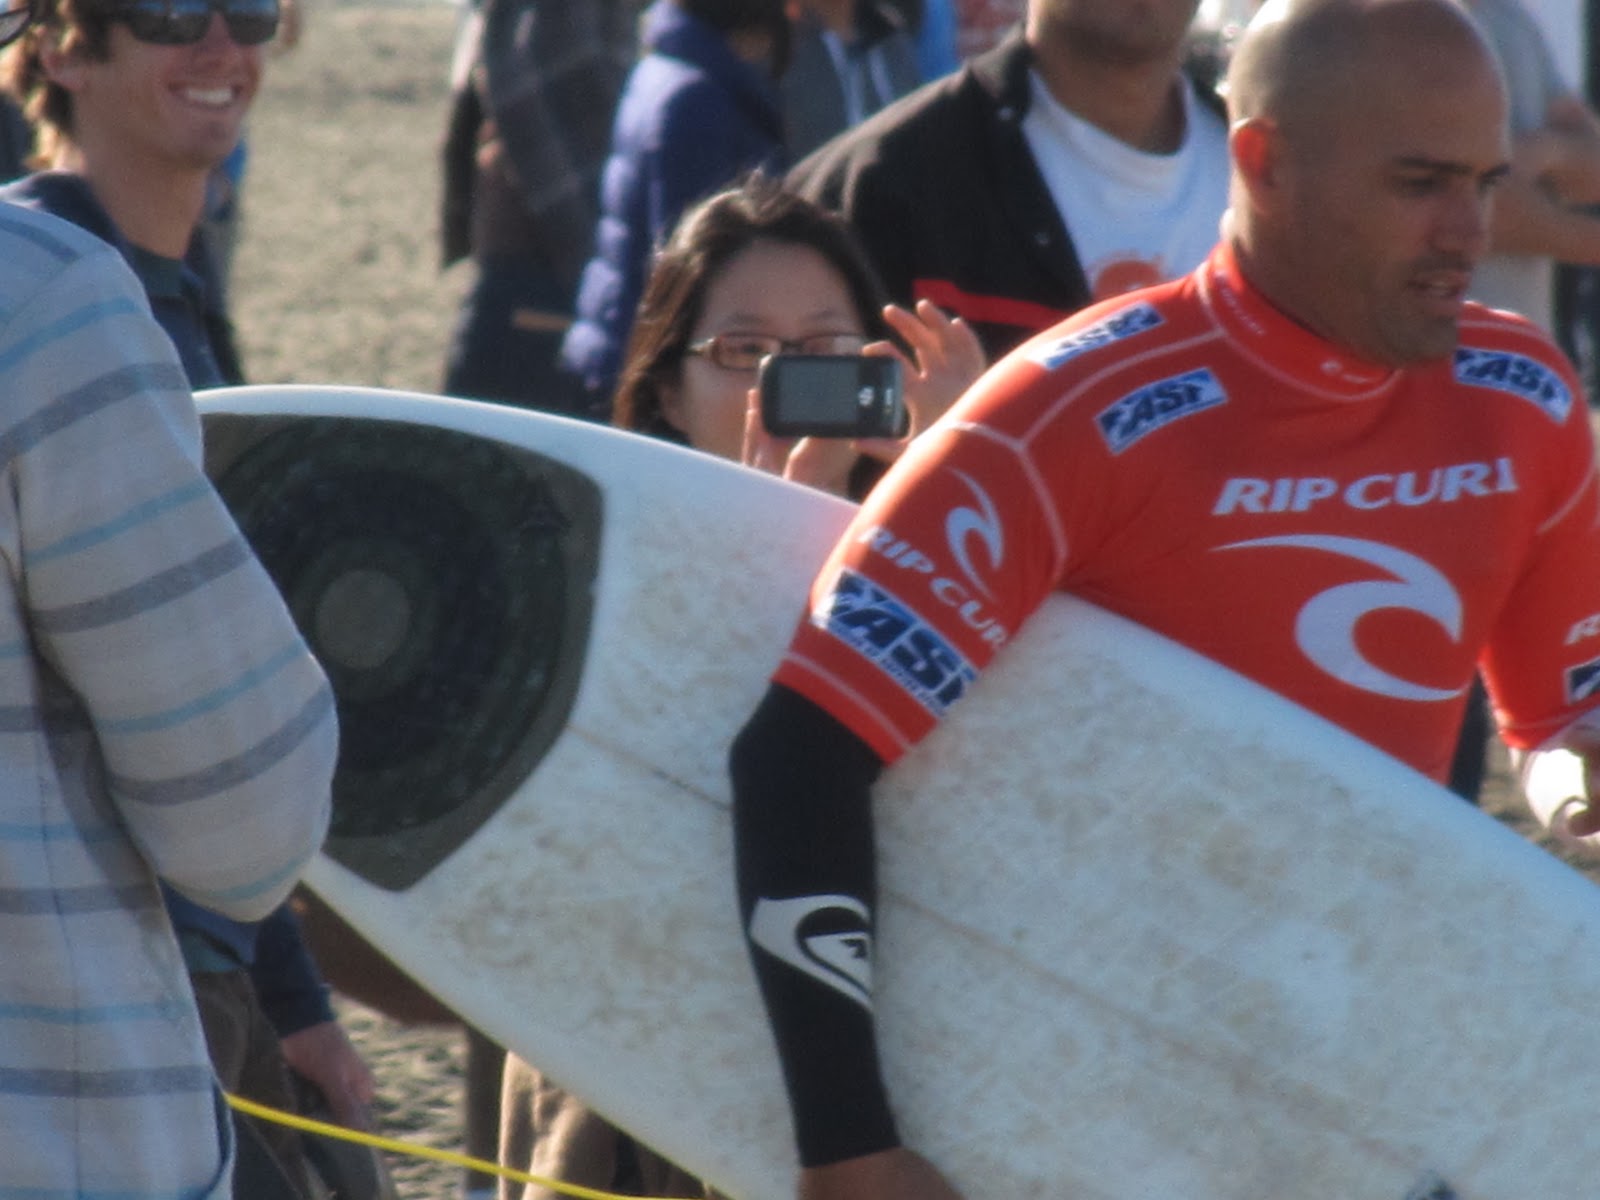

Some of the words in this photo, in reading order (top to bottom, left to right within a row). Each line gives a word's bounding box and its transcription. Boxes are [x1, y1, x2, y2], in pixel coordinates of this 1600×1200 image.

[1211, 477, 1339, 516] RIP
[857, 525, 936, 574] RIP
[930, 577, 1008, 645] CUR
